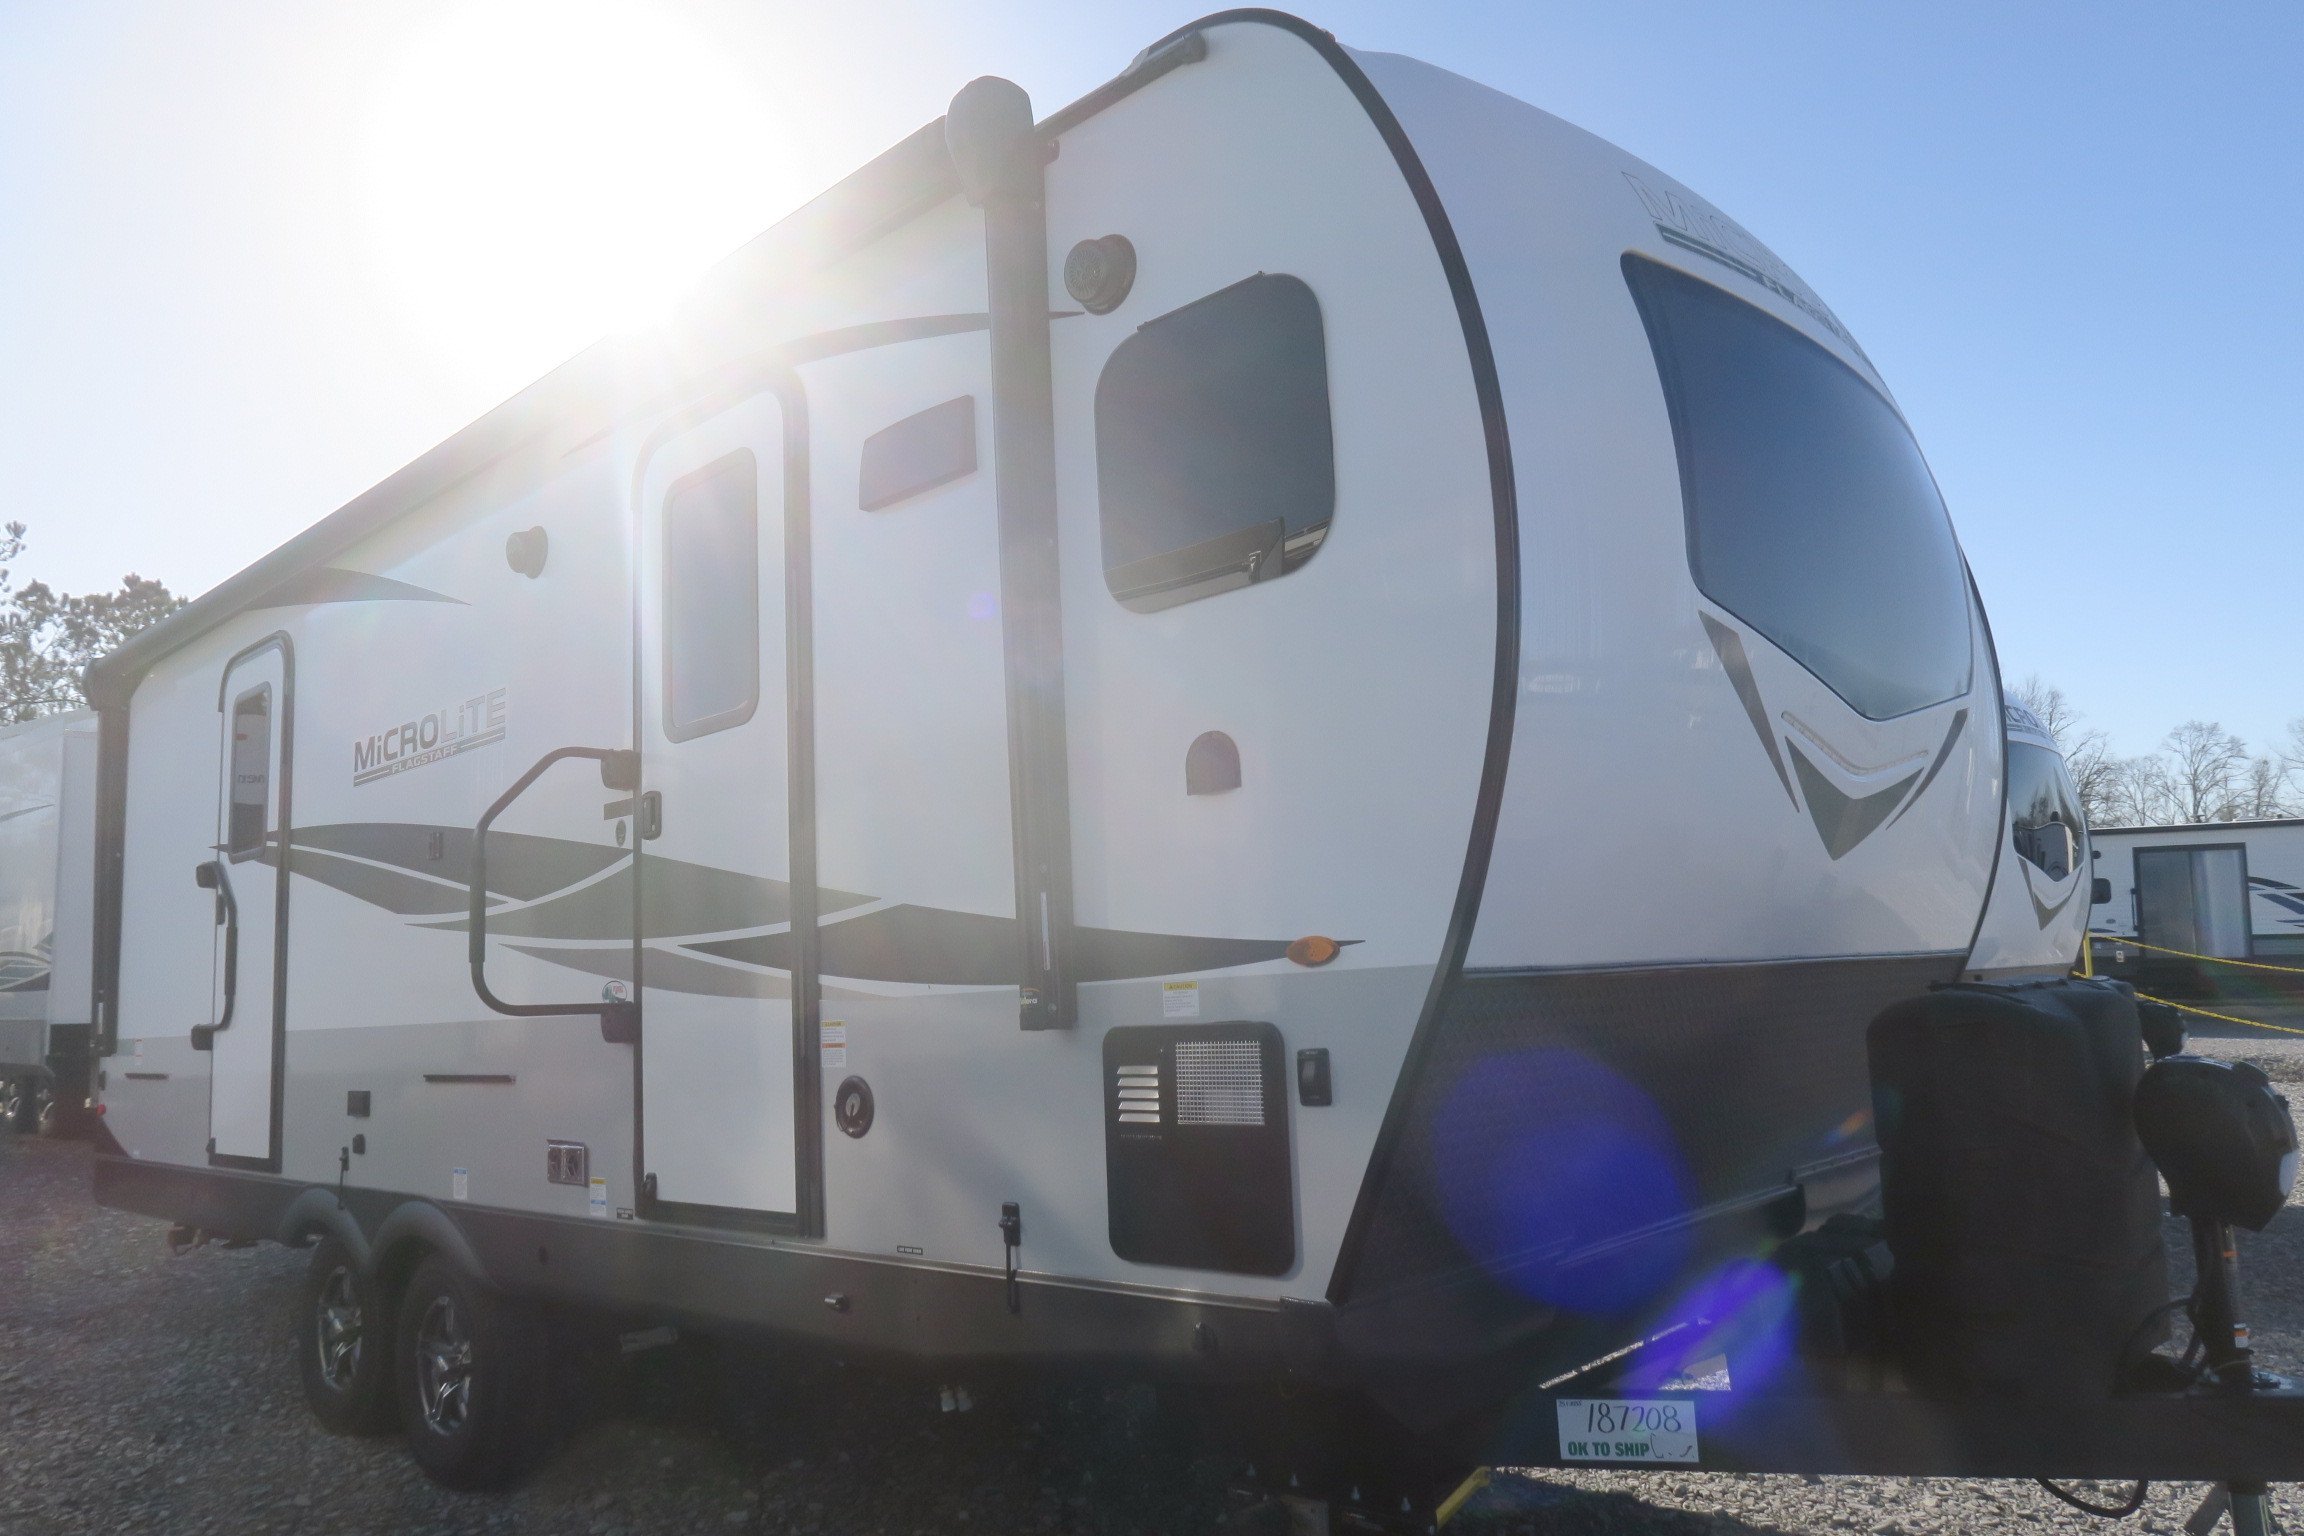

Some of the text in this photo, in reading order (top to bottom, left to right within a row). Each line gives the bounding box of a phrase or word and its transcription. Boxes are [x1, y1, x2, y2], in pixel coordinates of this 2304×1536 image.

[392, 744, 458, 774] FLAGSTAFF
[1588, 1402, 1682, 1434] 187208
[1567, 1441, 1588, 1456] OK
[1591, 1442, 1611, 1456] TO
[1614, 1442, 1650, 1457] SHIP
